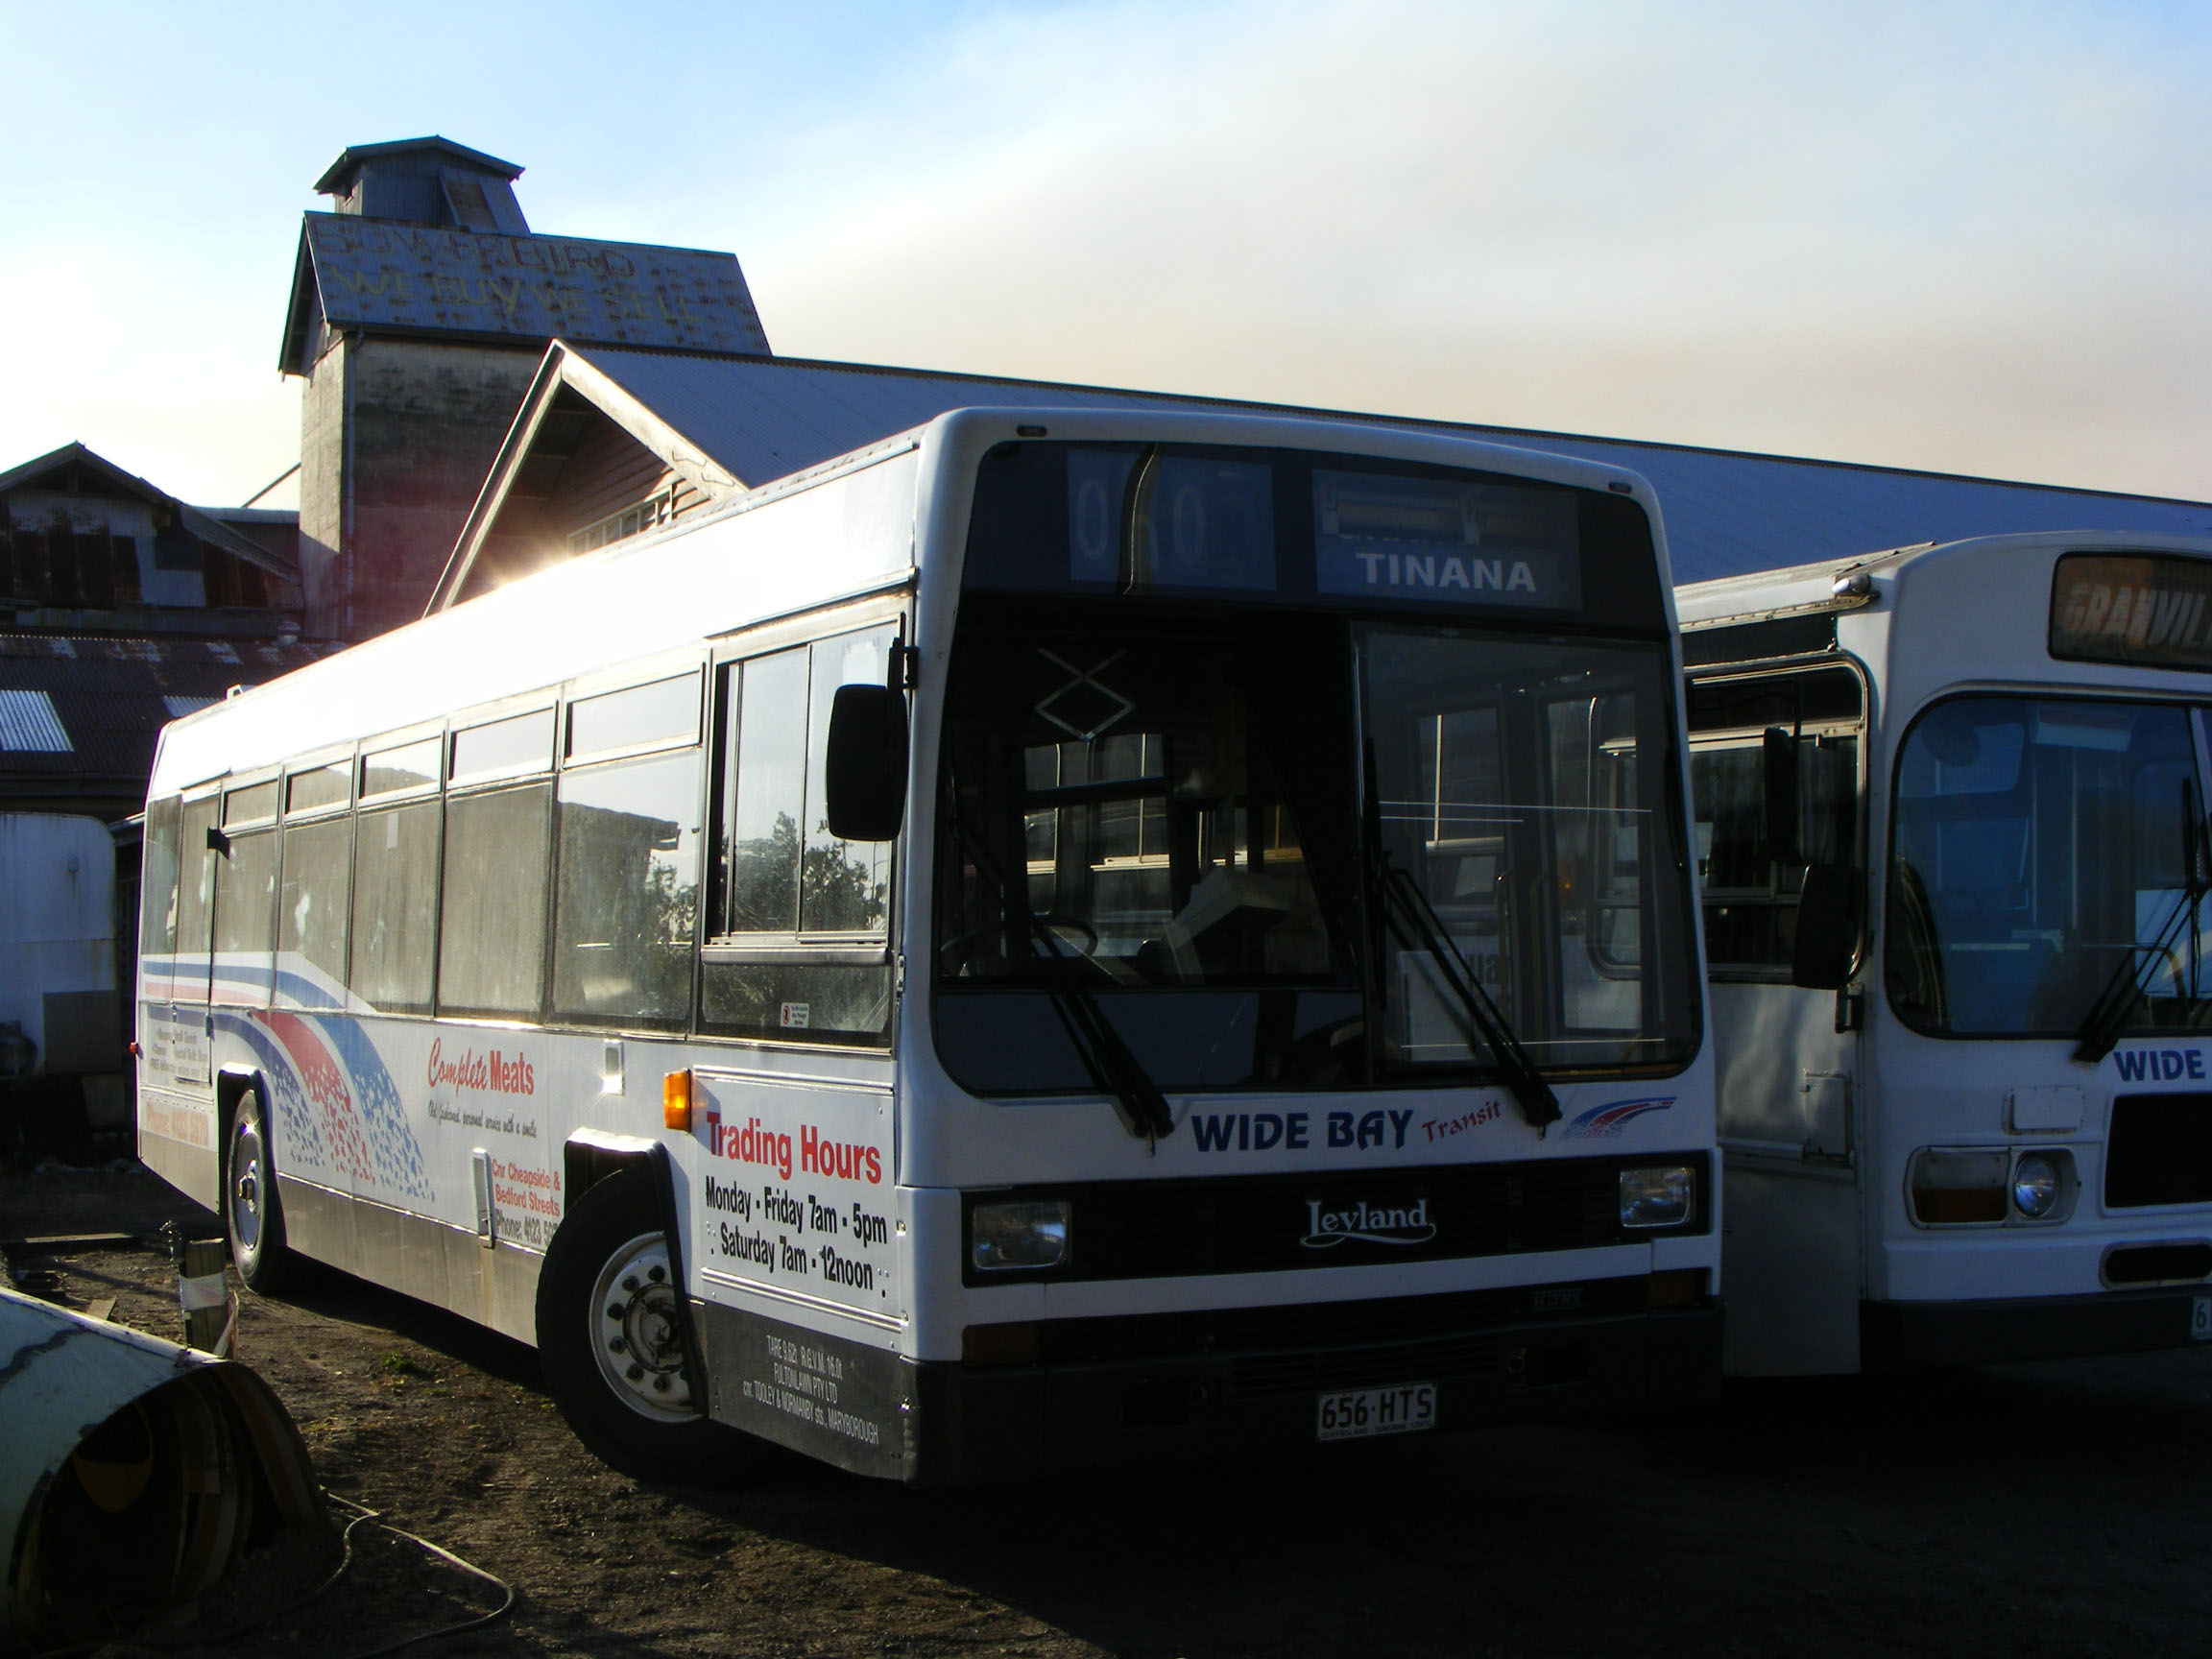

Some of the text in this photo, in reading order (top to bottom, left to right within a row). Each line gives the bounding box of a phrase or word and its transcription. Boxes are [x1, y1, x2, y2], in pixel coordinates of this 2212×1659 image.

[1355, 551, 1537, 592] TINANA
[427, 1037, 534, 1097] Complete Meats
[2114, 1049, 2205, 1082] WIDE
[1191, 1098, 1502, 1151] WIDE BAY Transit
[707, 1111, 881, 1185] Trading Hours
[492, 1159, 562, 1190] Cnr Cheapside &
[494, 1184, 561, 1217] Bedford Streets
[706, 1175, 751, 1222] Monday
[764, 1187, 803, 1234] Friday
[808, 1194, 837, 1234] 7am
[853, 1202, 887, 1248] 5pm
[1304, 1199, 1434, 1245] Leyland
[720, 1222, 775, 1273] Saturday
[780, 1235, 806, 1274] 7am
[821, 1246, 873, 1290] 12noon
[766, 1334, 782, 1359] TARE
[754, 1380, 775, 1406] TOOLEY
[776, 1389, 781, 1408] &
[828, 1407, 878, 1445] MARYBOROUGH
[813, 1376, 825, 1399] PTY
[825, 1382, 838, 1404] LTD
